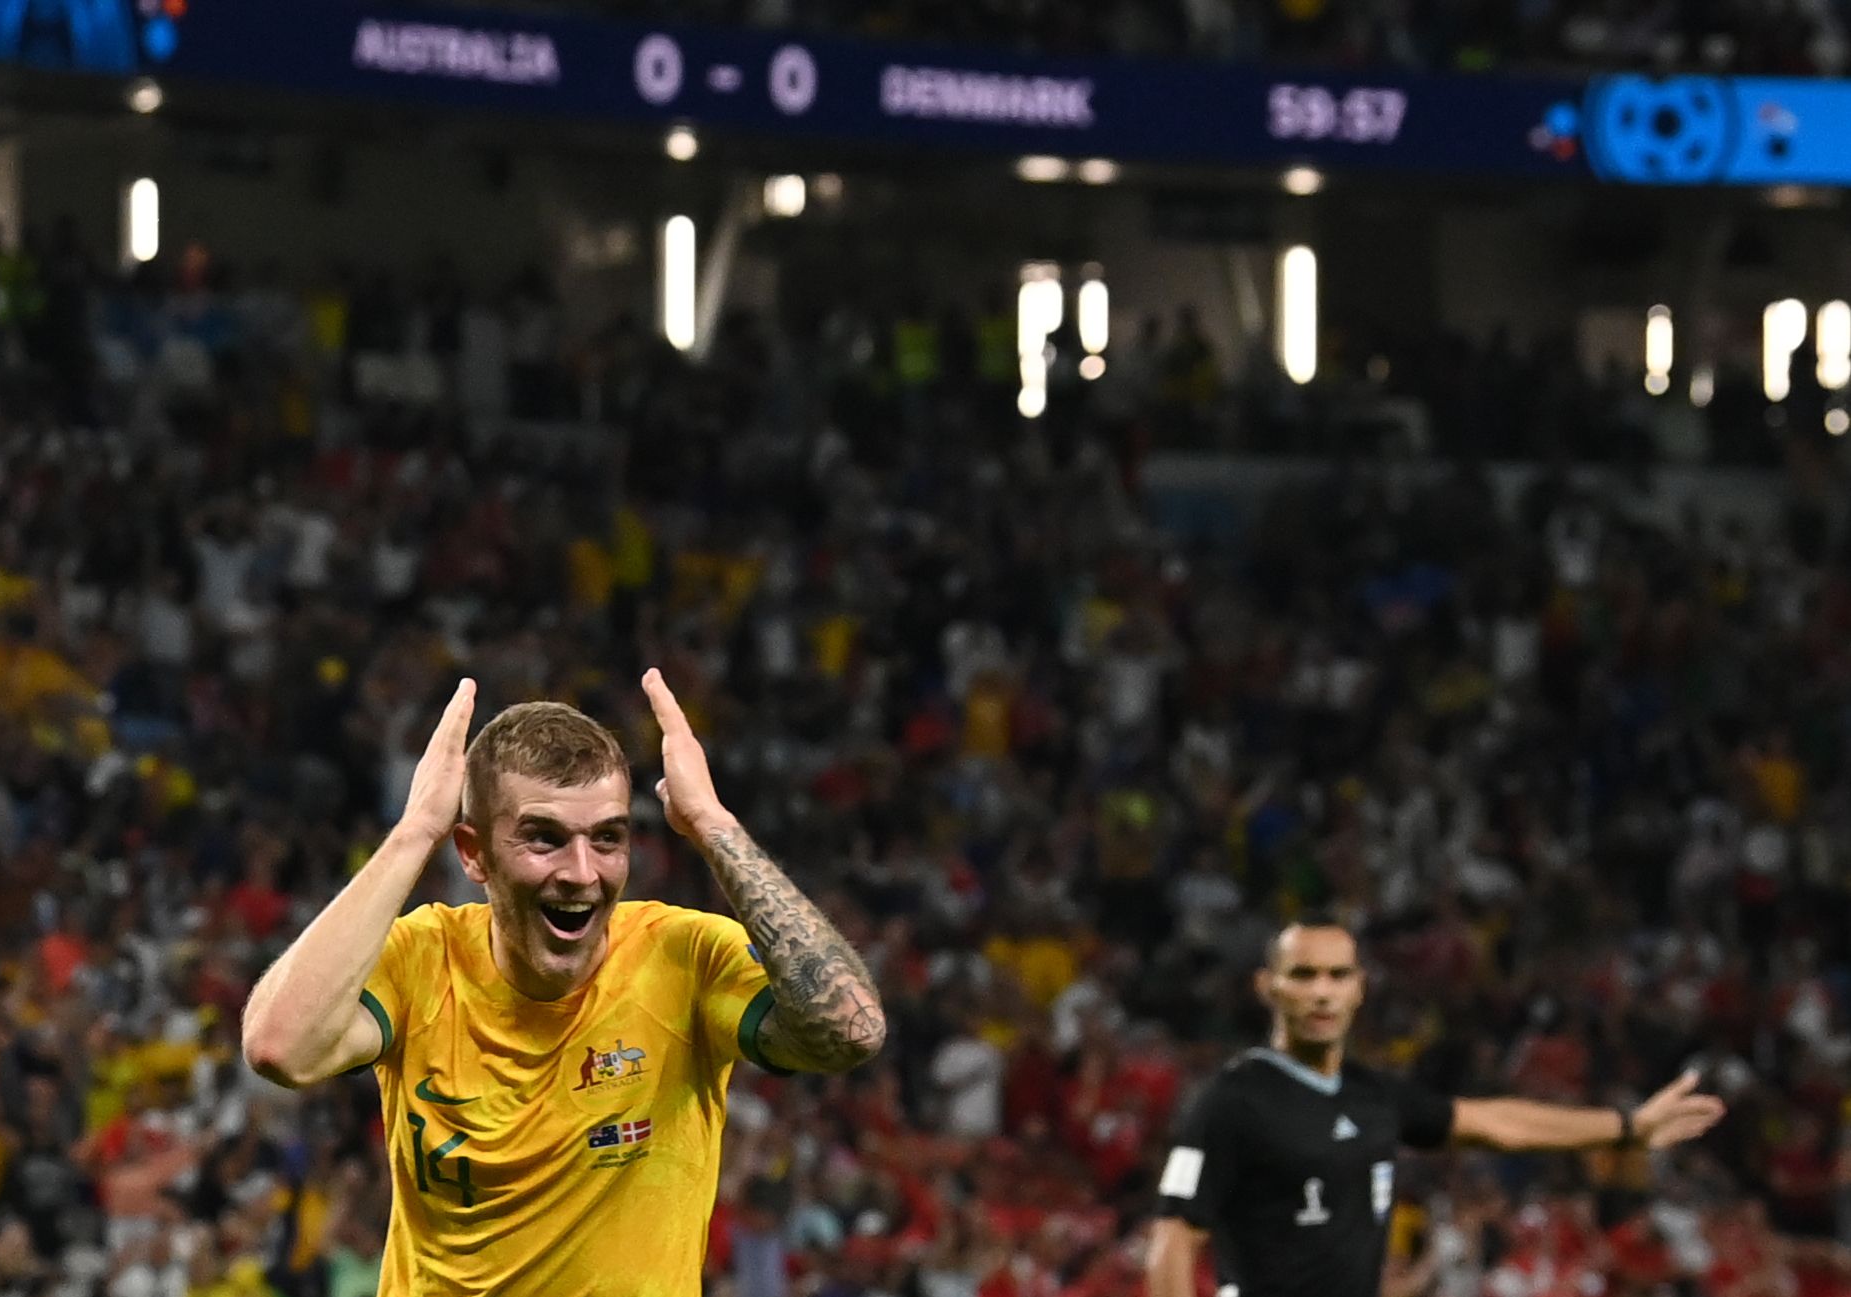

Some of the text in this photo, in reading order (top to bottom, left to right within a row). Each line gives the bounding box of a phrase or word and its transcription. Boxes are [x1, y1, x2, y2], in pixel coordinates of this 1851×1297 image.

[354, 20, 560, 83] AUSTRALIA
[633, 34, 684, 104] 0
[768, 45, 818, 113] 0
[881, 66, 1093, 127] DENMARK
[1268, 84, 1407, 142] 59:57
[407, 1111, 474, 1208] 14
